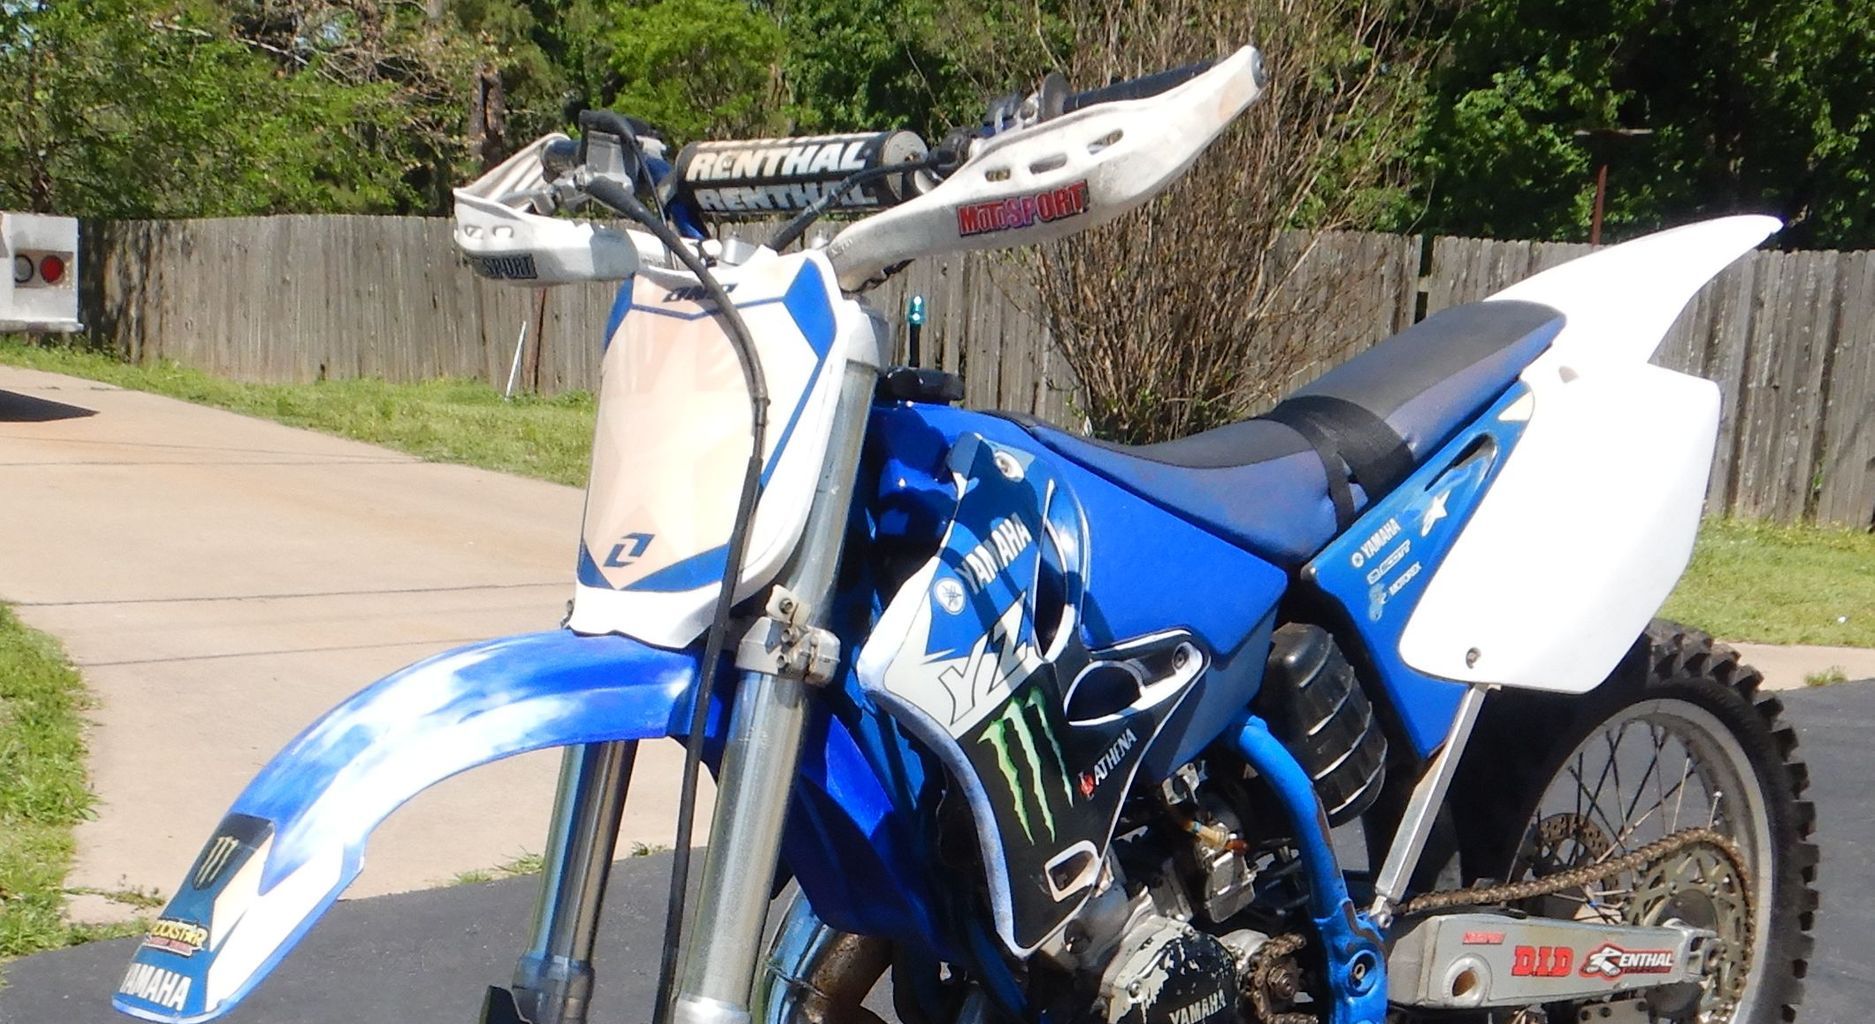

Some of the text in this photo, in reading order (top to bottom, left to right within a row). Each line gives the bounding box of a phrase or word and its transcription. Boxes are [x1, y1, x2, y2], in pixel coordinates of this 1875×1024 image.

[686, 140, 869, 183] RENTHAL
[954, 511, 1033, 595] YAMAHA
[1360, 518, 1401, 558] YAMAHA
[938, 591, 1029, 726] YZ
[1094, 728, 1137, 786] ATHENA
